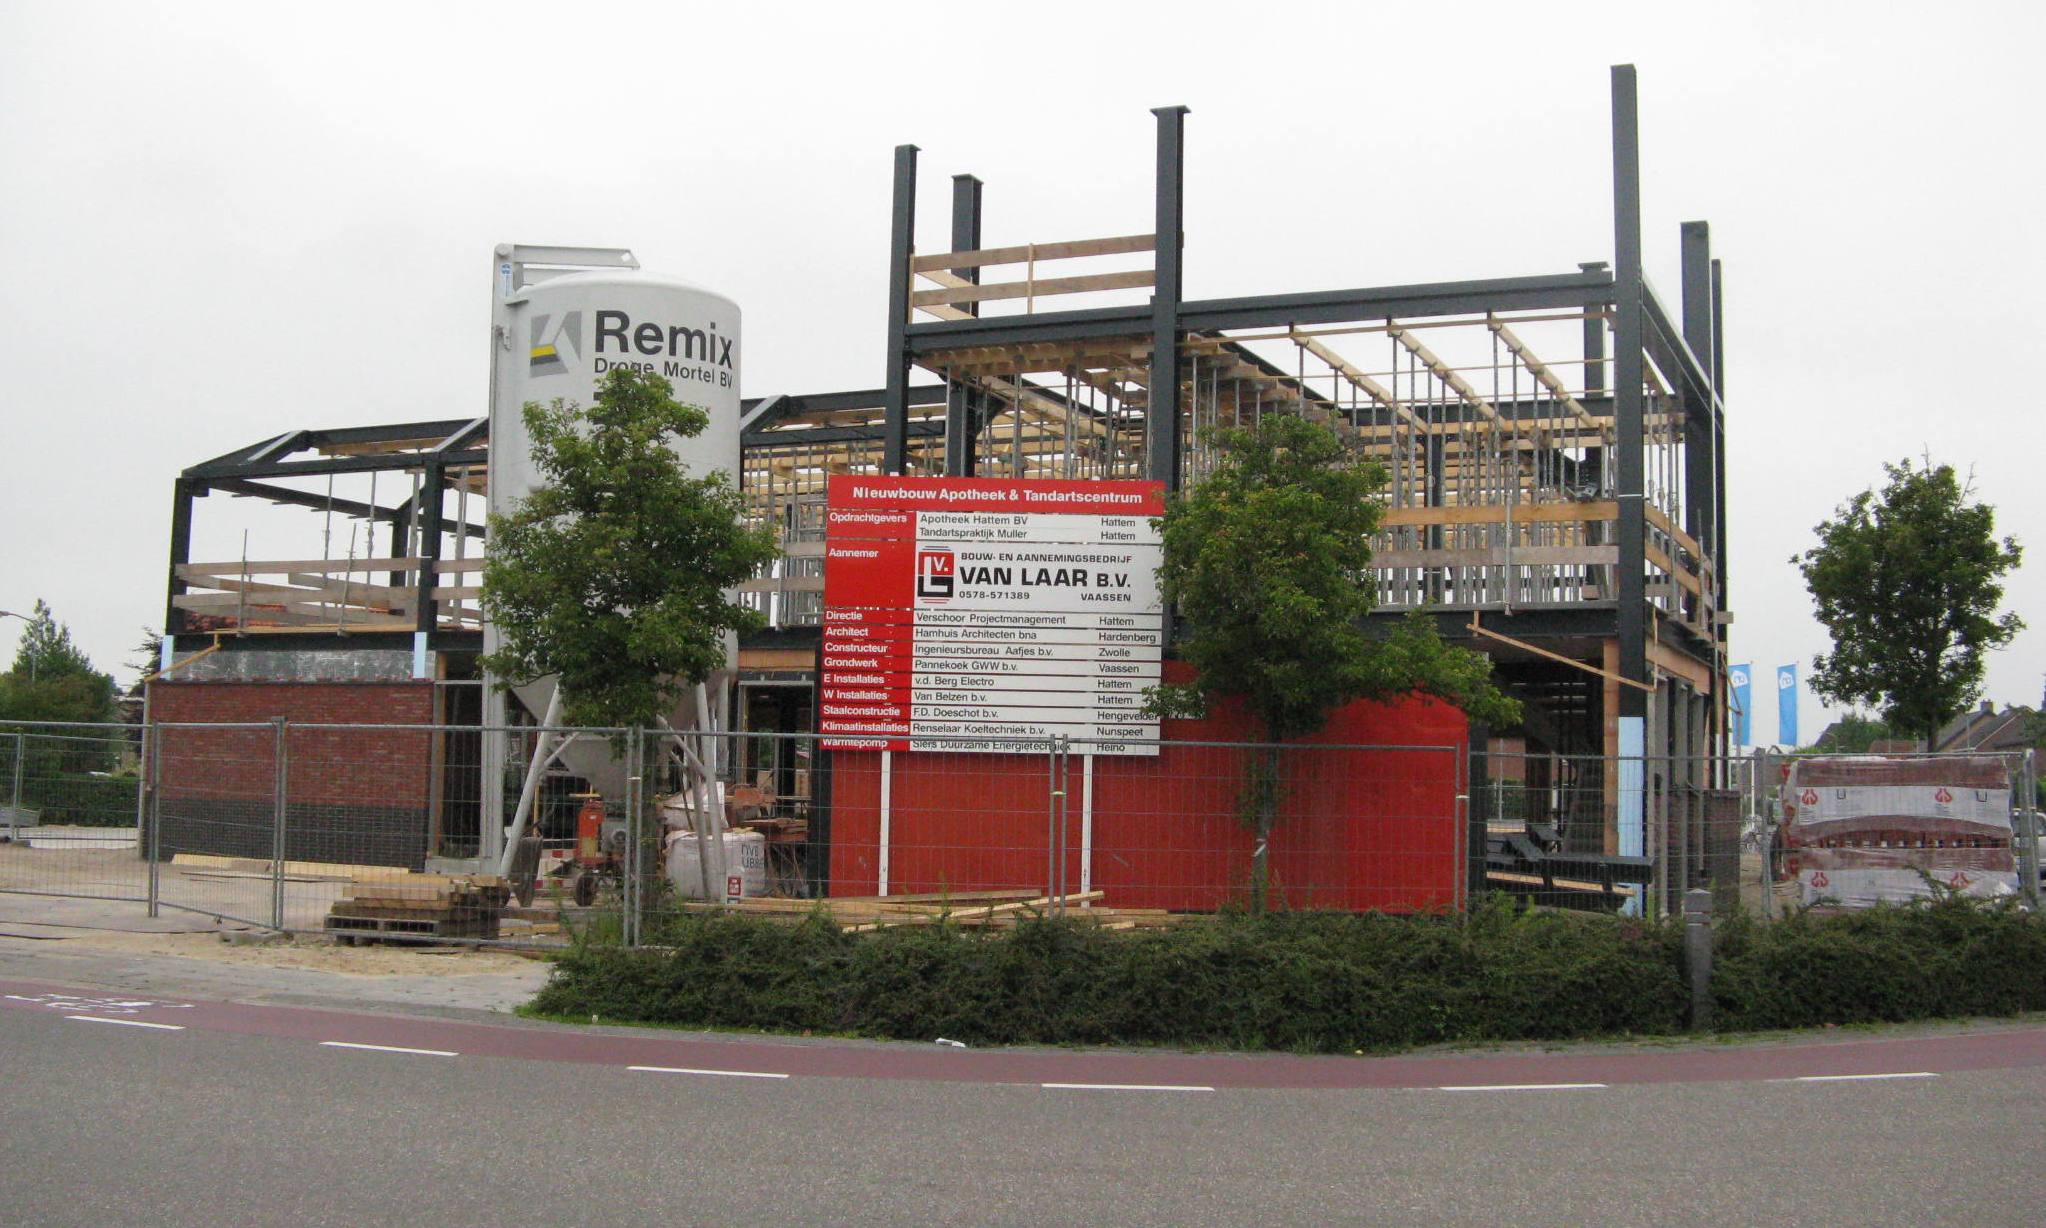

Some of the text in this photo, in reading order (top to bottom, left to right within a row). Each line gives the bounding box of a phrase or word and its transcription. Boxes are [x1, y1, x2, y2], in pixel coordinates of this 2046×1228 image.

[595, 309, 733, 370] Remix
[663, 360, 715, 384] Mortel
[720, 371, 733, 390] BV
[939, 488, 1006, 503] Apotheek
[1009, 489, 1019, 501] &
[1024, 490, 1143, 504] Tandartscentrum
[829, 512, 907, 523] Opdrachtgevers
[920, 514, 1028, 525] Apotheek Hattem BV
[1101, 518, 1136, 527] Hattem
[920, 528, 1028, 540] Tandartspraktijk Muller
[1101, 531, 1136, 541] Hattem
[829, 548, 879, 558] Aannemer
[961, 553, 1132, 564] BOUW- EN AANNEMINGSBEDRIJF
[959, 566, 1131, 588] VAN LAAR B.V.
[959, 591, 1030, 600] 0578-571389
[1081, 593, 1131, 602] VAASSEN
[826, 610, 863, 621] Directie
[916, 613, 1066, 625] Verschoor Projectmanagement
[1099, 616, 1134, 627] Hattem
[826, 627, 869, 637] Architect
[915, 629, 1037, 640] Hamhuis Architecten bna
[1099, 632, 1157, 644] Hardenberg
[825, 642, 888, 653] Constructeur
[915, 645, 1054, 657] Ingenieursbureau Aafjes b.v.
[1099, 648, 1131, 658] Zwolle
[824, 658, 878, 668] Grondwerk
[915, 660, 1018, 671] Pannekoek GWW b.v.
[1099, 664, 1140, 673] Vaassen
[824, 674, 885, 685] E Installaties
[915, 676, 995, 688] v.d. Berg Electro
[1097, 680, 1132, 689] Hattem
[824, 690, 888, 701] W Installaties
[915, 692, 988, 702] Van Belzen b.v.
[1097, 695, 1133, 705] Hattem
[823, 705, 901, 717] Staalconstructie
[933, 708, 980, 718] Doeschot
[982, 709, 999, 718] b.v.
[822, 721, 909, 733] Klimaatinstallaties
[913, 724, 1046, 735] Renselaar Koeltechniek b.v.
[1096, 727, 1144, 737] Nunspeet
[940, 740, 990, 750] Duurzame
